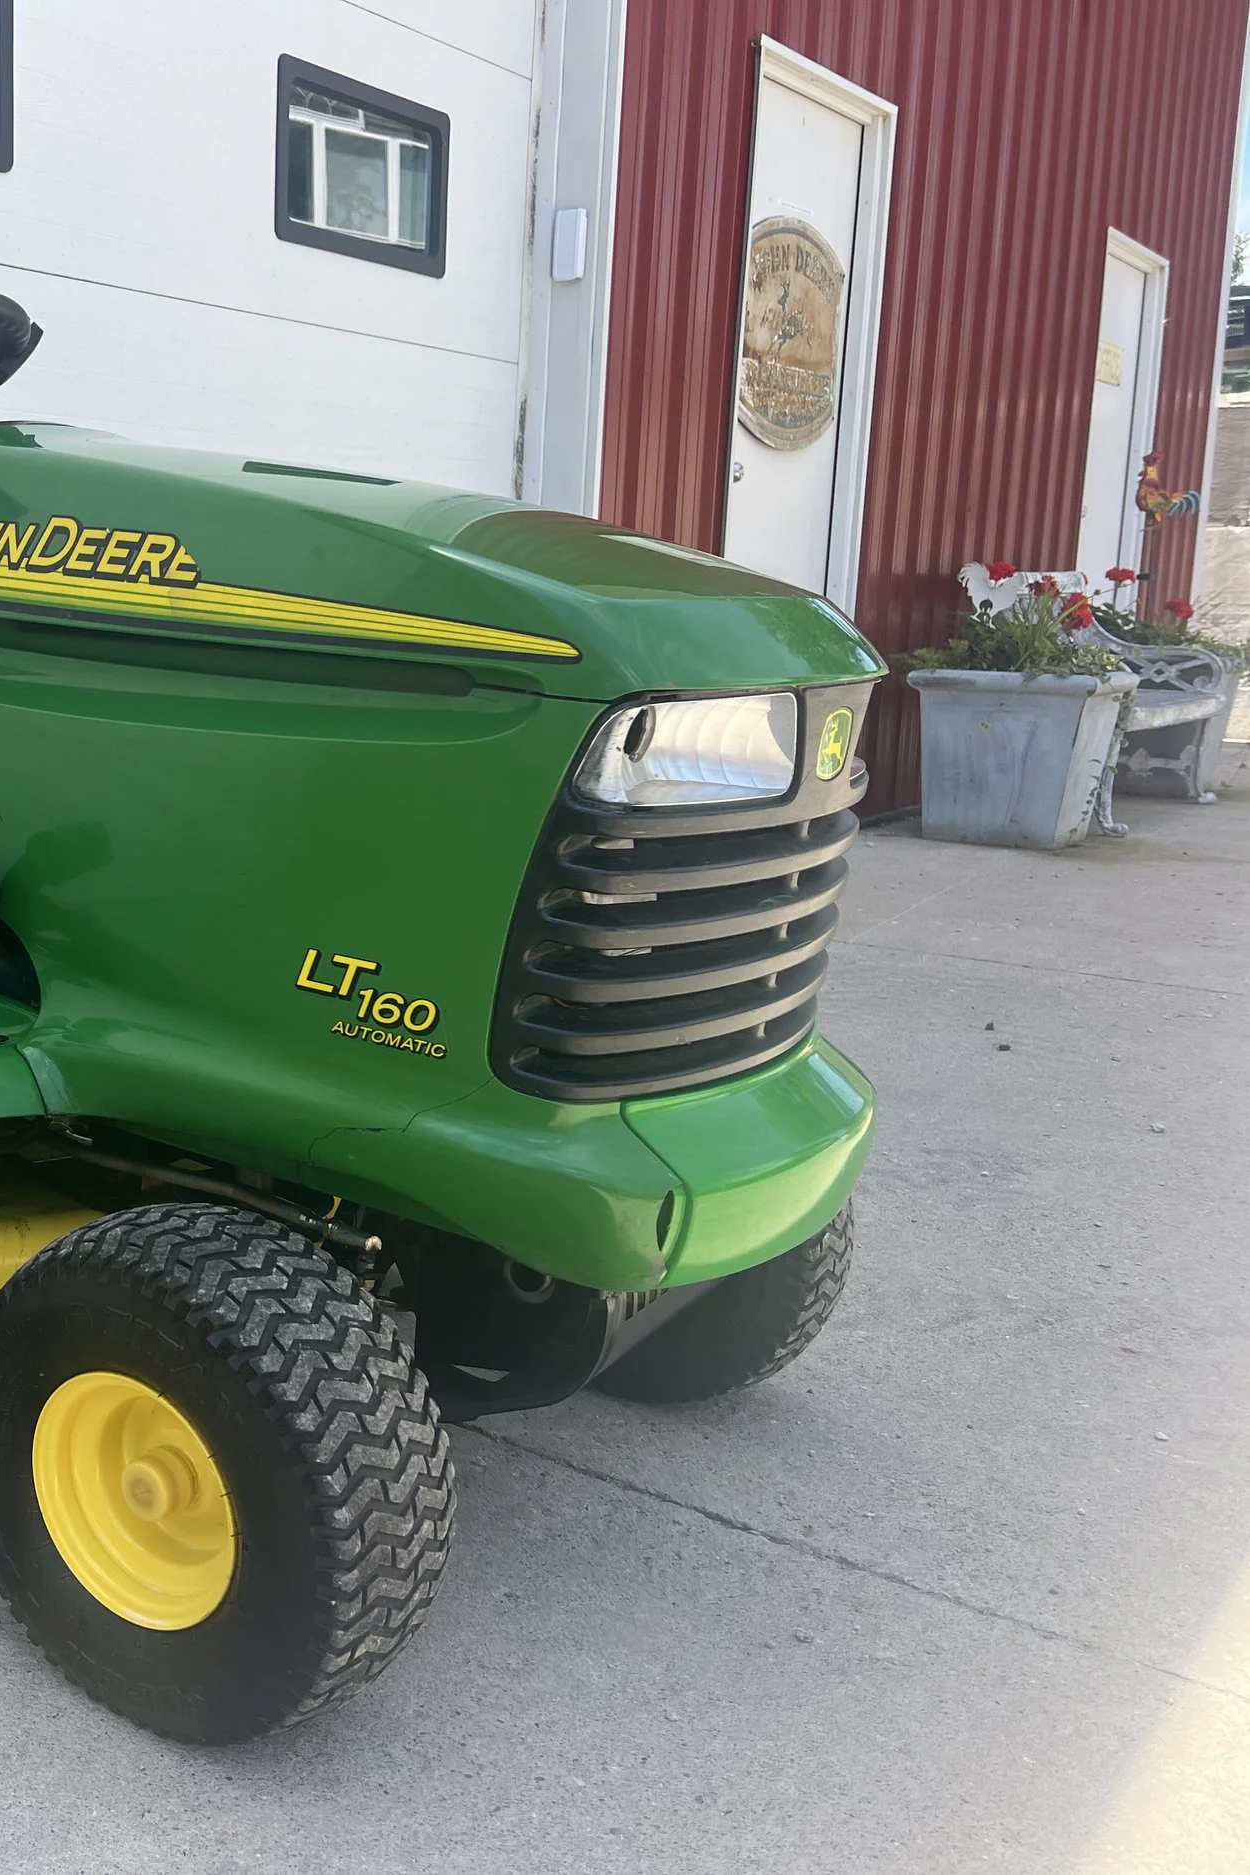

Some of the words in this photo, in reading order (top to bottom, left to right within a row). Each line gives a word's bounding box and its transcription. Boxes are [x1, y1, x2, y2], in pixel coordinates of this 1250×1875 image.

[25, 515, 199, 587] DEERE
[296, 948, 382, 1000] LT
[356, 987, 440, 1036] 160
[330, 1020, 447, 1059] AUTOMATIC
